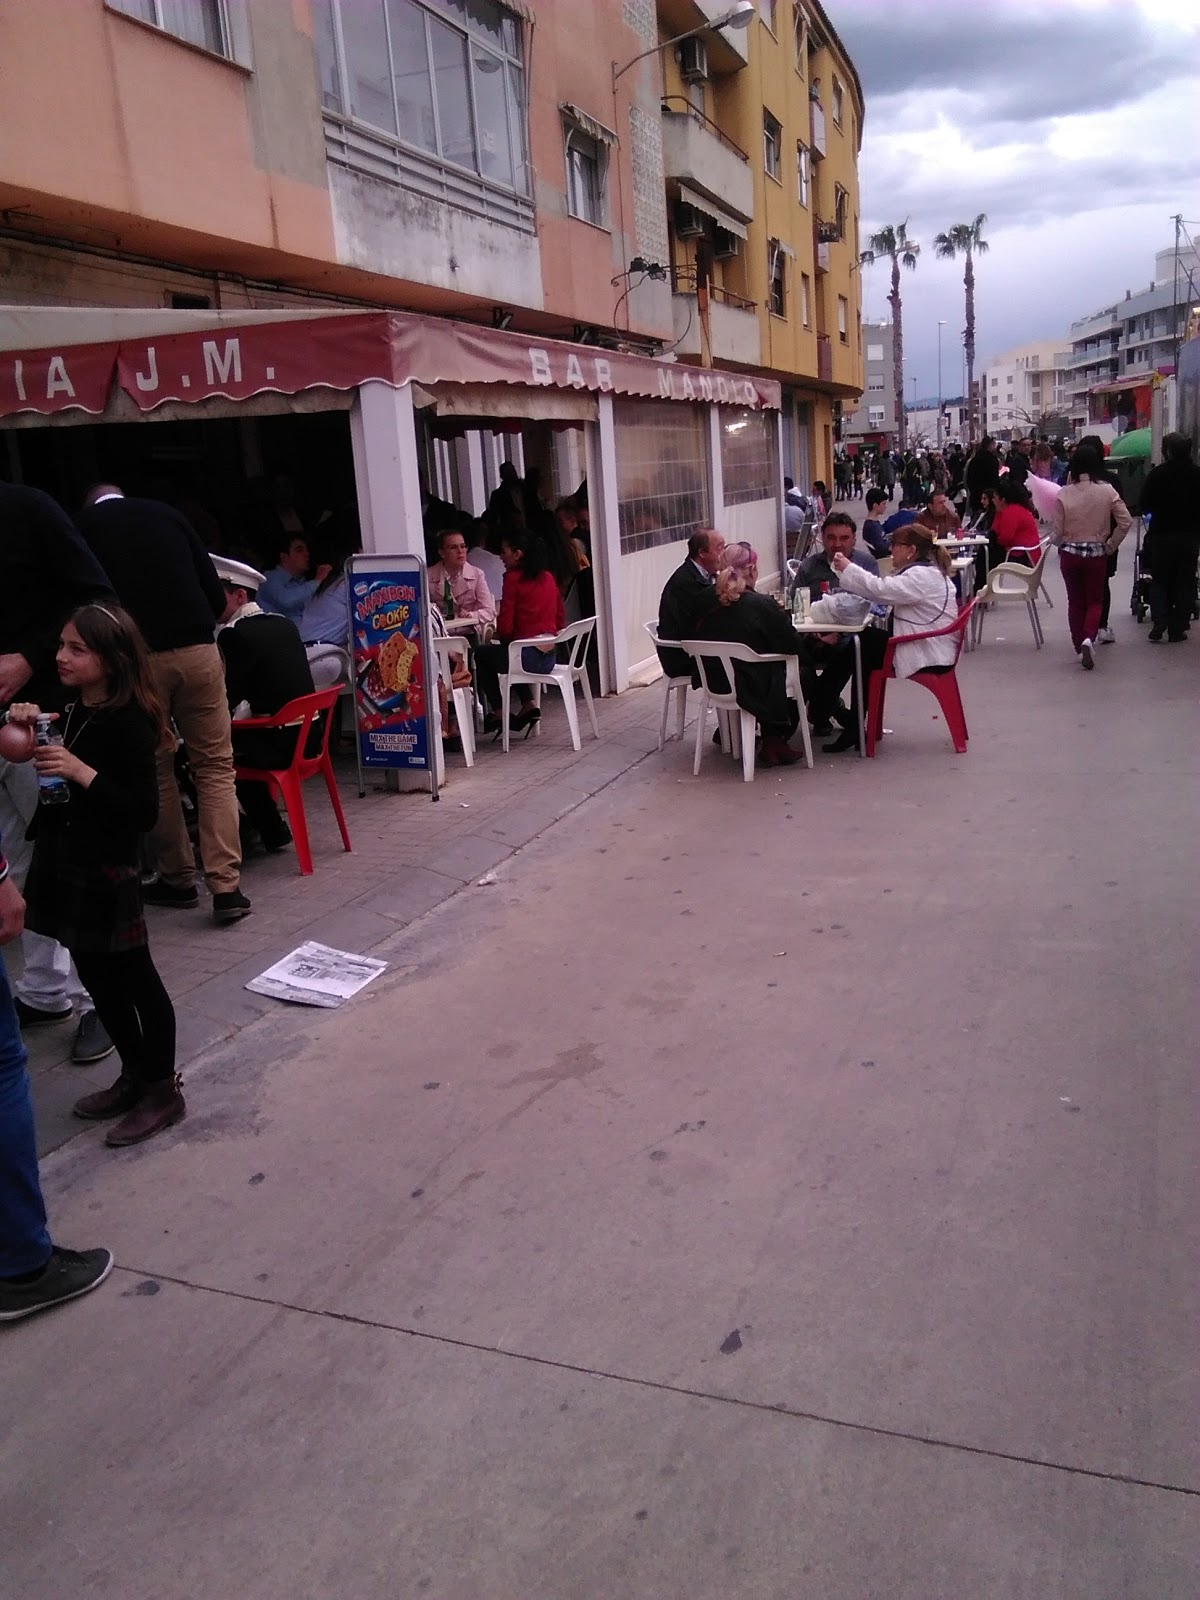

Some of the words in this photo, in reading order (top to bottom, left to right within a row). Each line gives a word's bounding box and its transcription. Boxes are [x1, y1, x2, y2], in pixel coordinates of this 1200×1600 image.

[529, 348, 613, 390] BAR
[657, 367, 760, 404] MANOLO
[356, 585, 416, 621] MAXIBON
[370, 734, 384, 743] MIX
[385, 734, 397, 744] THE
[397, 735, 417, 744] GAME
